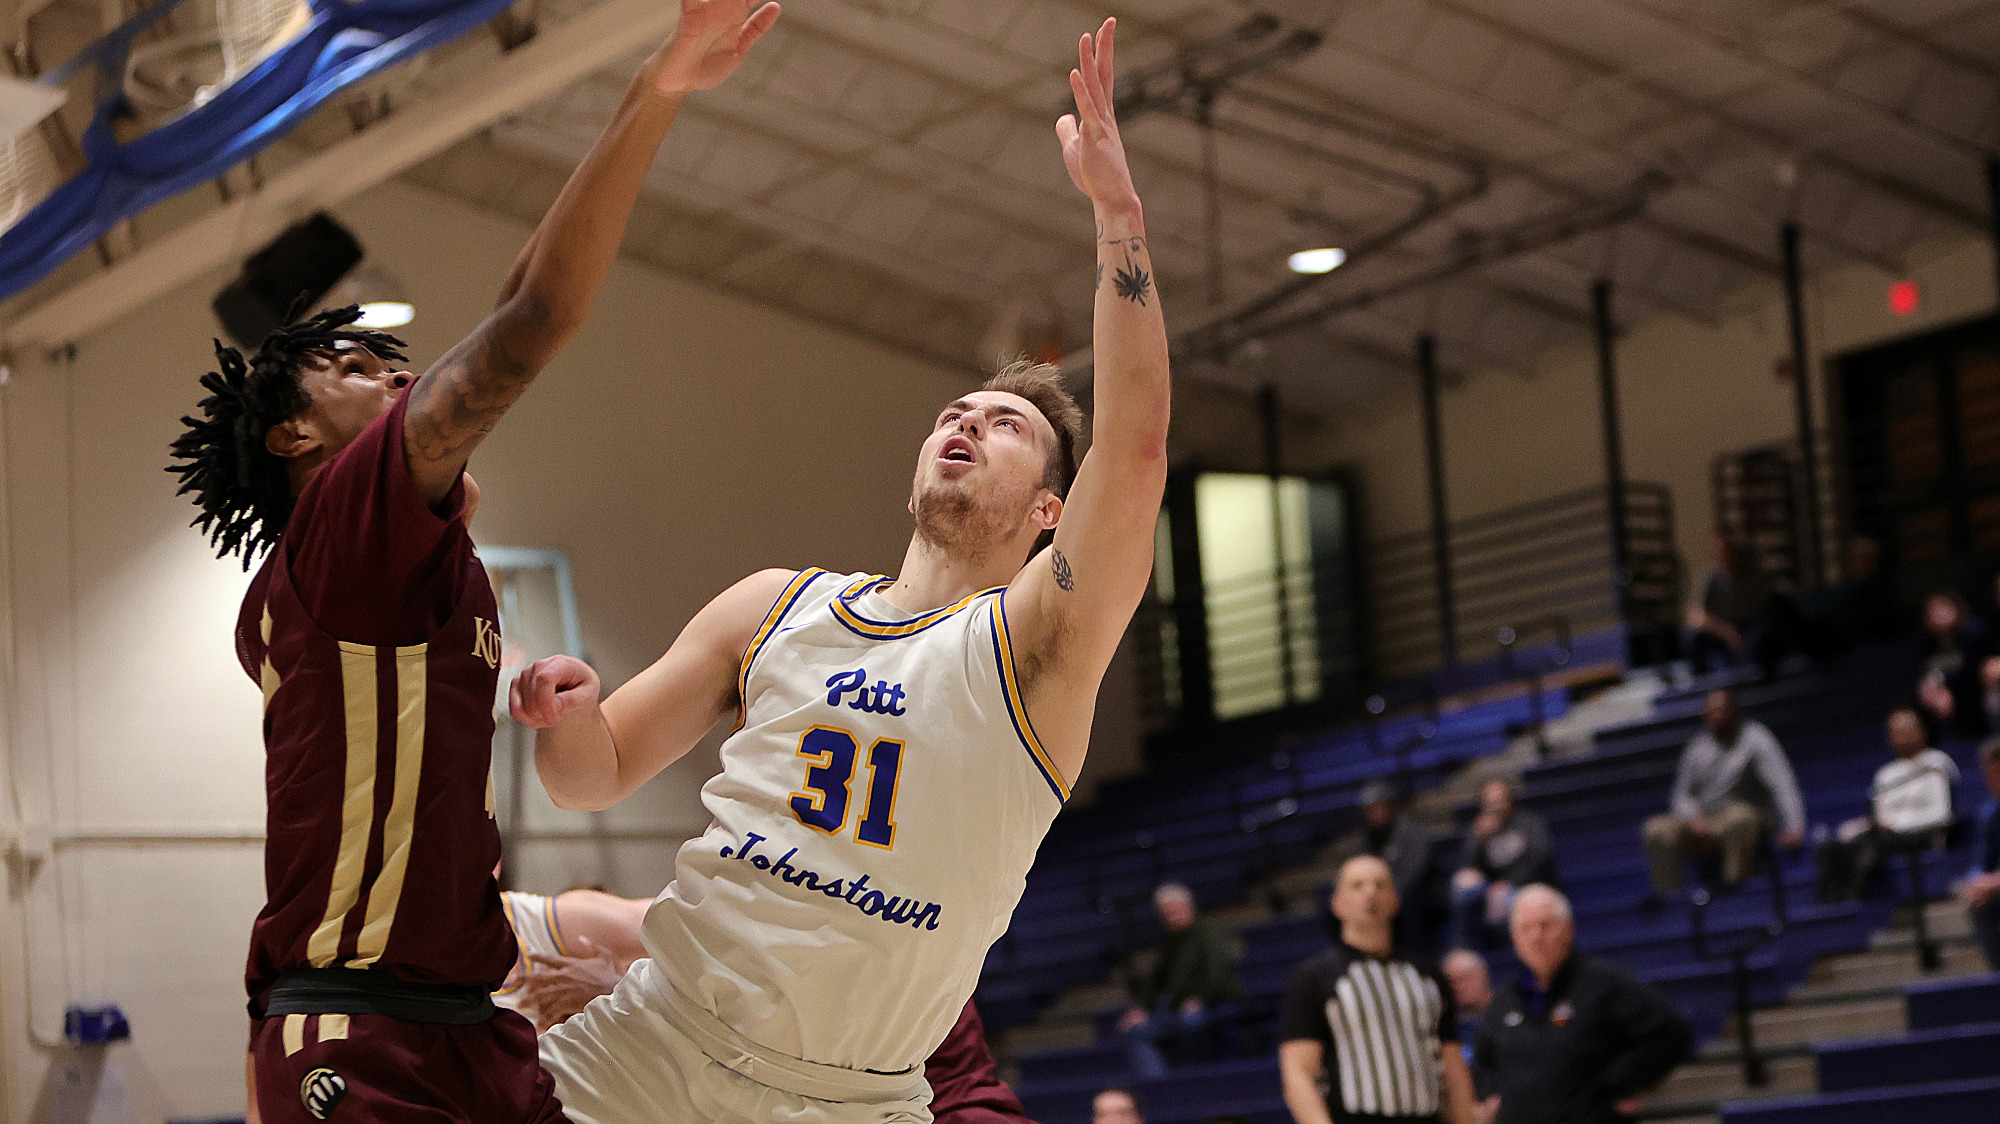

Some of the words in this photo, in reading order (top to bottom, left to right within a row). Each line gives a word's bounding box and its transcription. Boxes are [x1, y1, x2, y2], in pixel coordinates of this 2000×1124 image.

[826, 668, 906, 716] Pitt
[787, 724, 906, 851] 31
[720, 832, 942, 931] Johnstown
